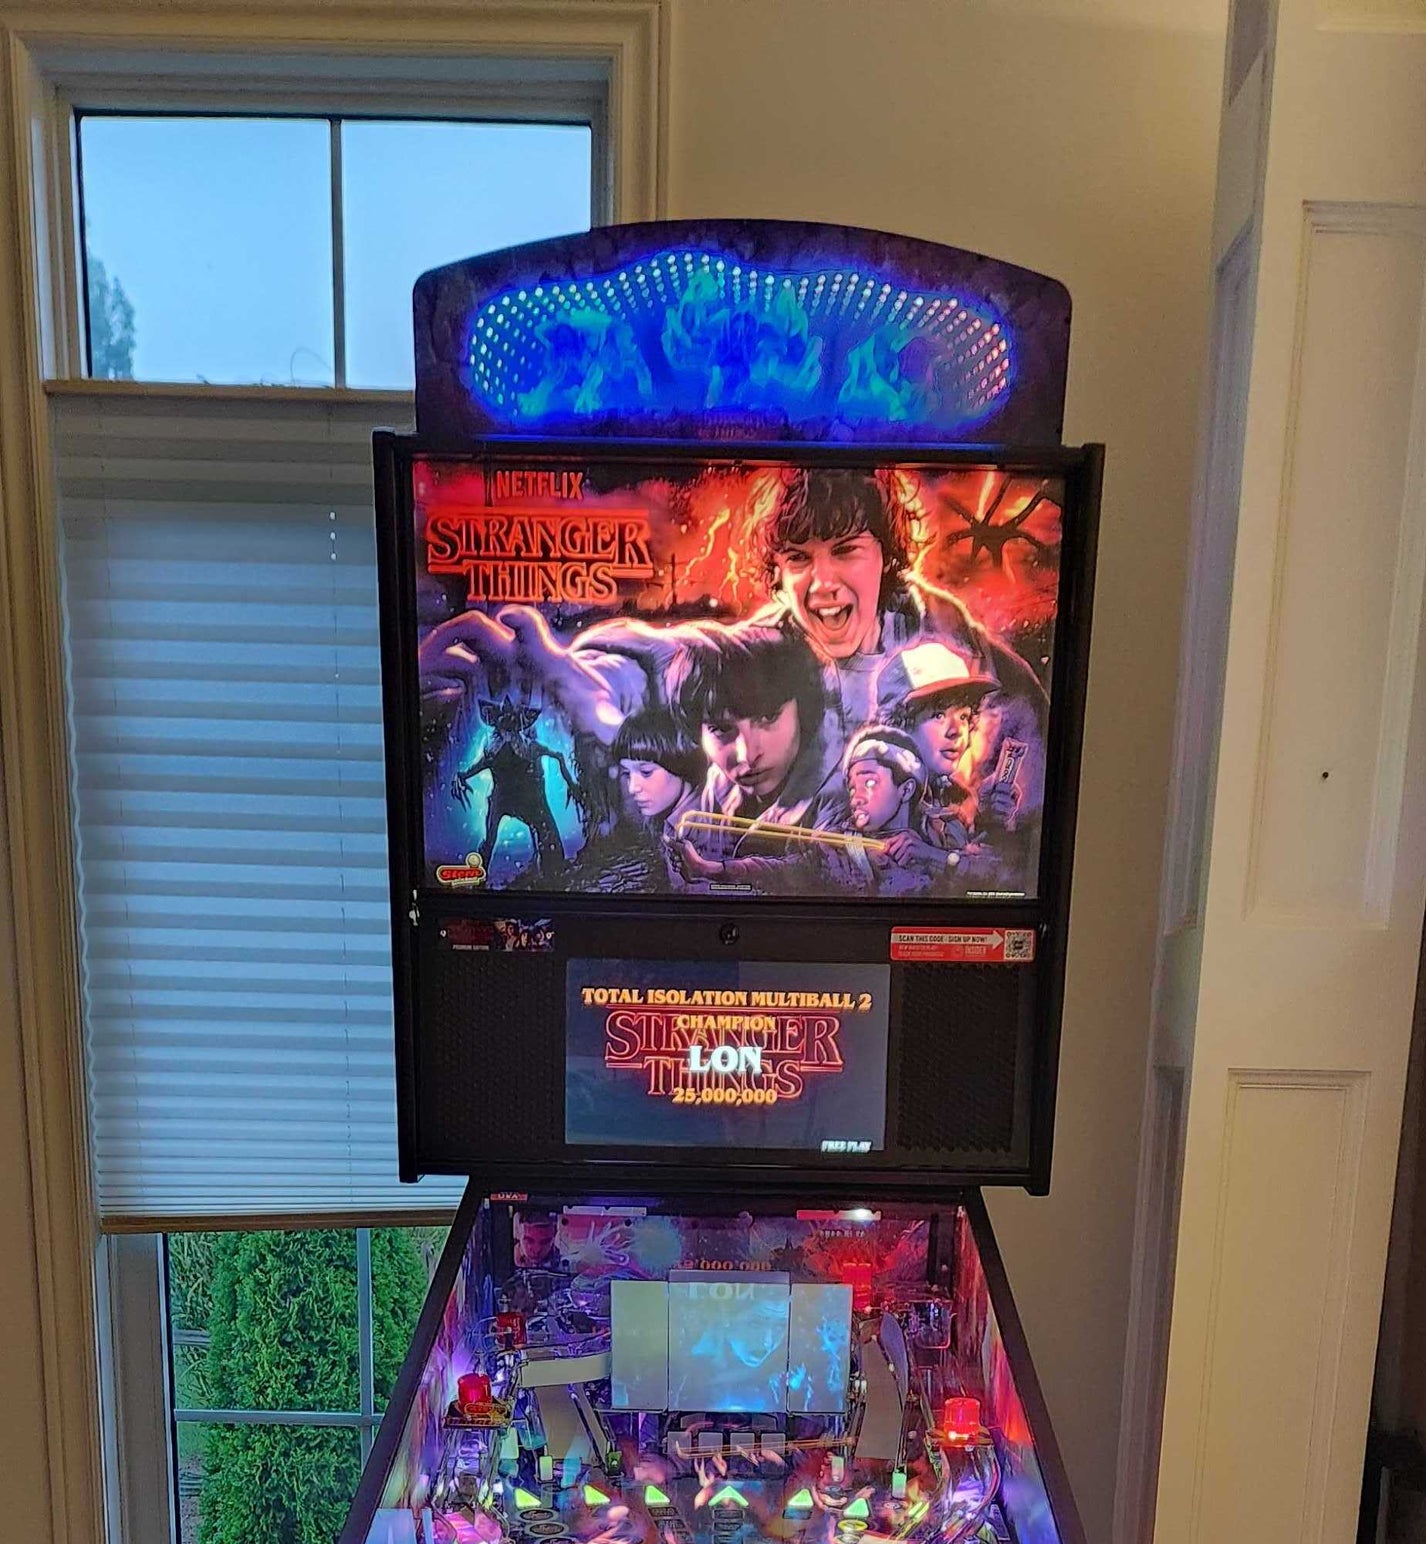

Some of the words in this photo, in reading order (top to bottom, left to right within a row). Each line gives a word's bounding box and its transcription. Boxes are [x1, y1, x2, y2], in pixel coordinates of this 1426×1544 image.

[496, 470, 583, 499] NETFLIX
[427, 515, 653, 568] STRANGER
[463, 559, 618, 604] THINGS
[929, 935, 944, 943] CODE
[582, 988, 643, 1005] TOTAL
[646, 989, 749, 1006] ISOLATION
[750, 991, 856, 1008] MULTIBALL
[857, 993, 873, 1010] 2
[676, 1014, 777, 1031] CHAMPION
[605, 1011, 843, 1064] STRANGER
[688, 1045, 763, 1074] LON
[644, 1056, 804, 1099] THINGS
[671, 1087, 778, 1105] 25,000,000
[821, 1140, 847, 1153] FREE
[847, 1141, 872, 1153] PLAY
